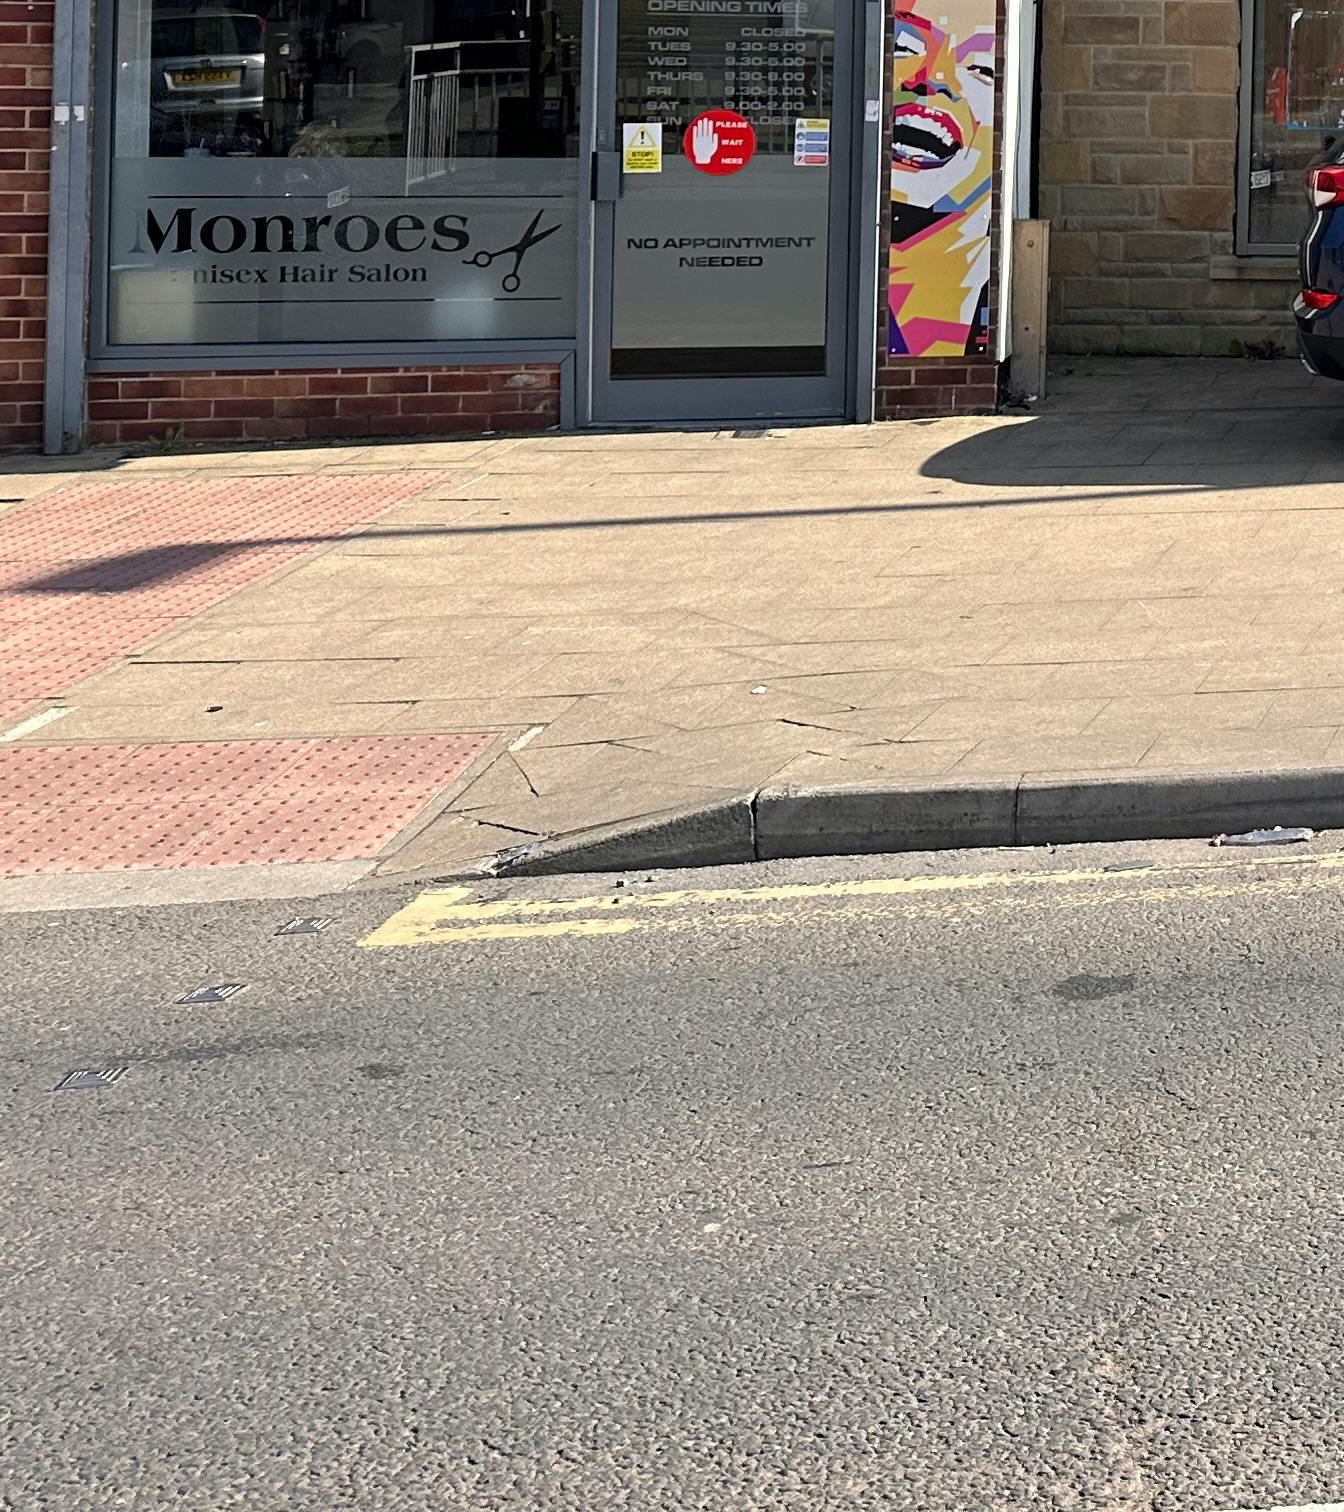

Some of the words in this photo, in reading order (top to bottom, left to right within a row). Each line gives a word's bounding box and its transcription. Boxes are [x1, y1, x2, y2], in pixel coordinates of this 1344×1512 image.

[648, 0, 741, 13] OPENING
[745, 1, 808, 13] TIMES
[648, 27, 689, 36] MON
[741, 27, 806, 37] CLOSED
[647, 42, 691, 51] TUES
[647, 56, 687, 66] WED
[646, 72, 704, 81] THURS
[646, 86, 672, 96] FRI
[646, 101, 680, 110] SAT
[715, 120, 749, 129] PLEASE
[721, 157, 744, 165] HERE
[128, 207, 470, 254] Monroes
[627, 238, 658, 249] NO
[663, 236, 816, 249] APPOINTMENT
[679, 256, 763, 267] NEEDED
[279, 263, 338, 284] Hair
[347, 263, 428, 284] Salon
